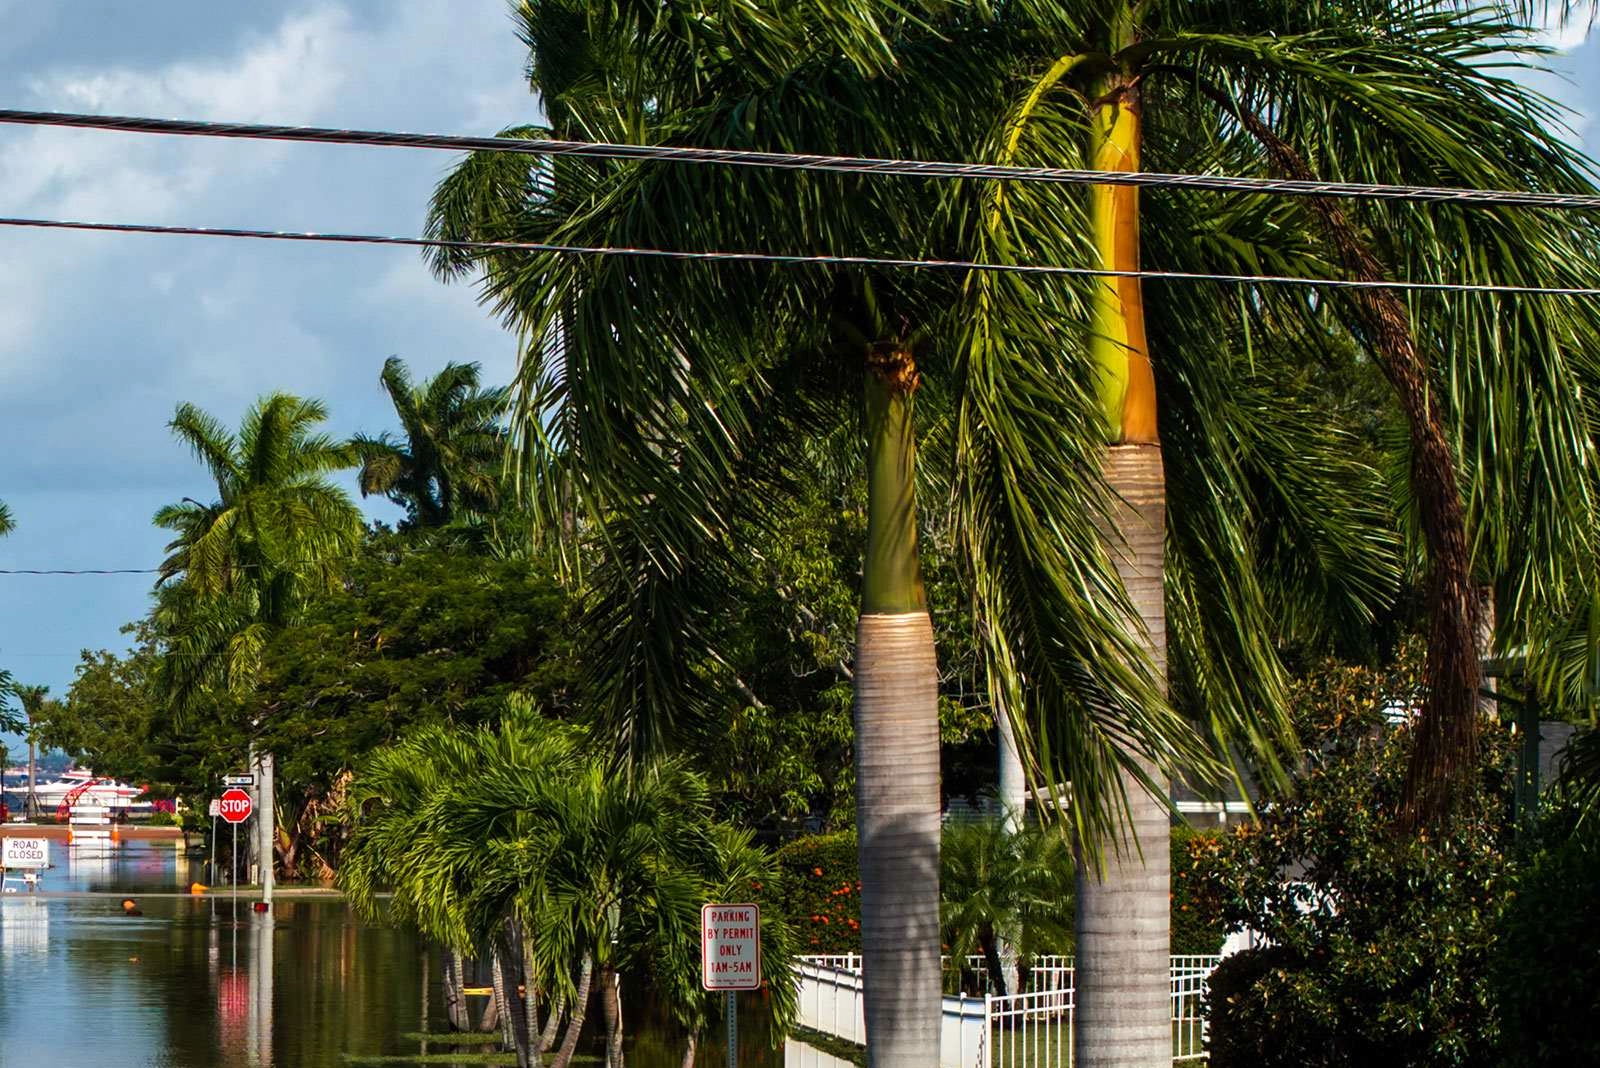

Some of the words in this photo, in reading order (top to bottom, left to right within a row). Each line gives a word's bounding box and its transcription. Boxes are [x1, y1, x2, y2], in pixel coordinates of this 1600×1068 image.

[221, 799, 249, 812] STOP
[12, 840, 39, 849] ROAD
[8, 850, 44, 859] CLOSED
[711, 911, 750, 922] PARKING
[708, 928, 719, 939] BY
[723, 928, 753, 939] PERMIT
[719, 944, 742, 956] ONLY
[711, 961, 752, 973] 1AM-5AM
